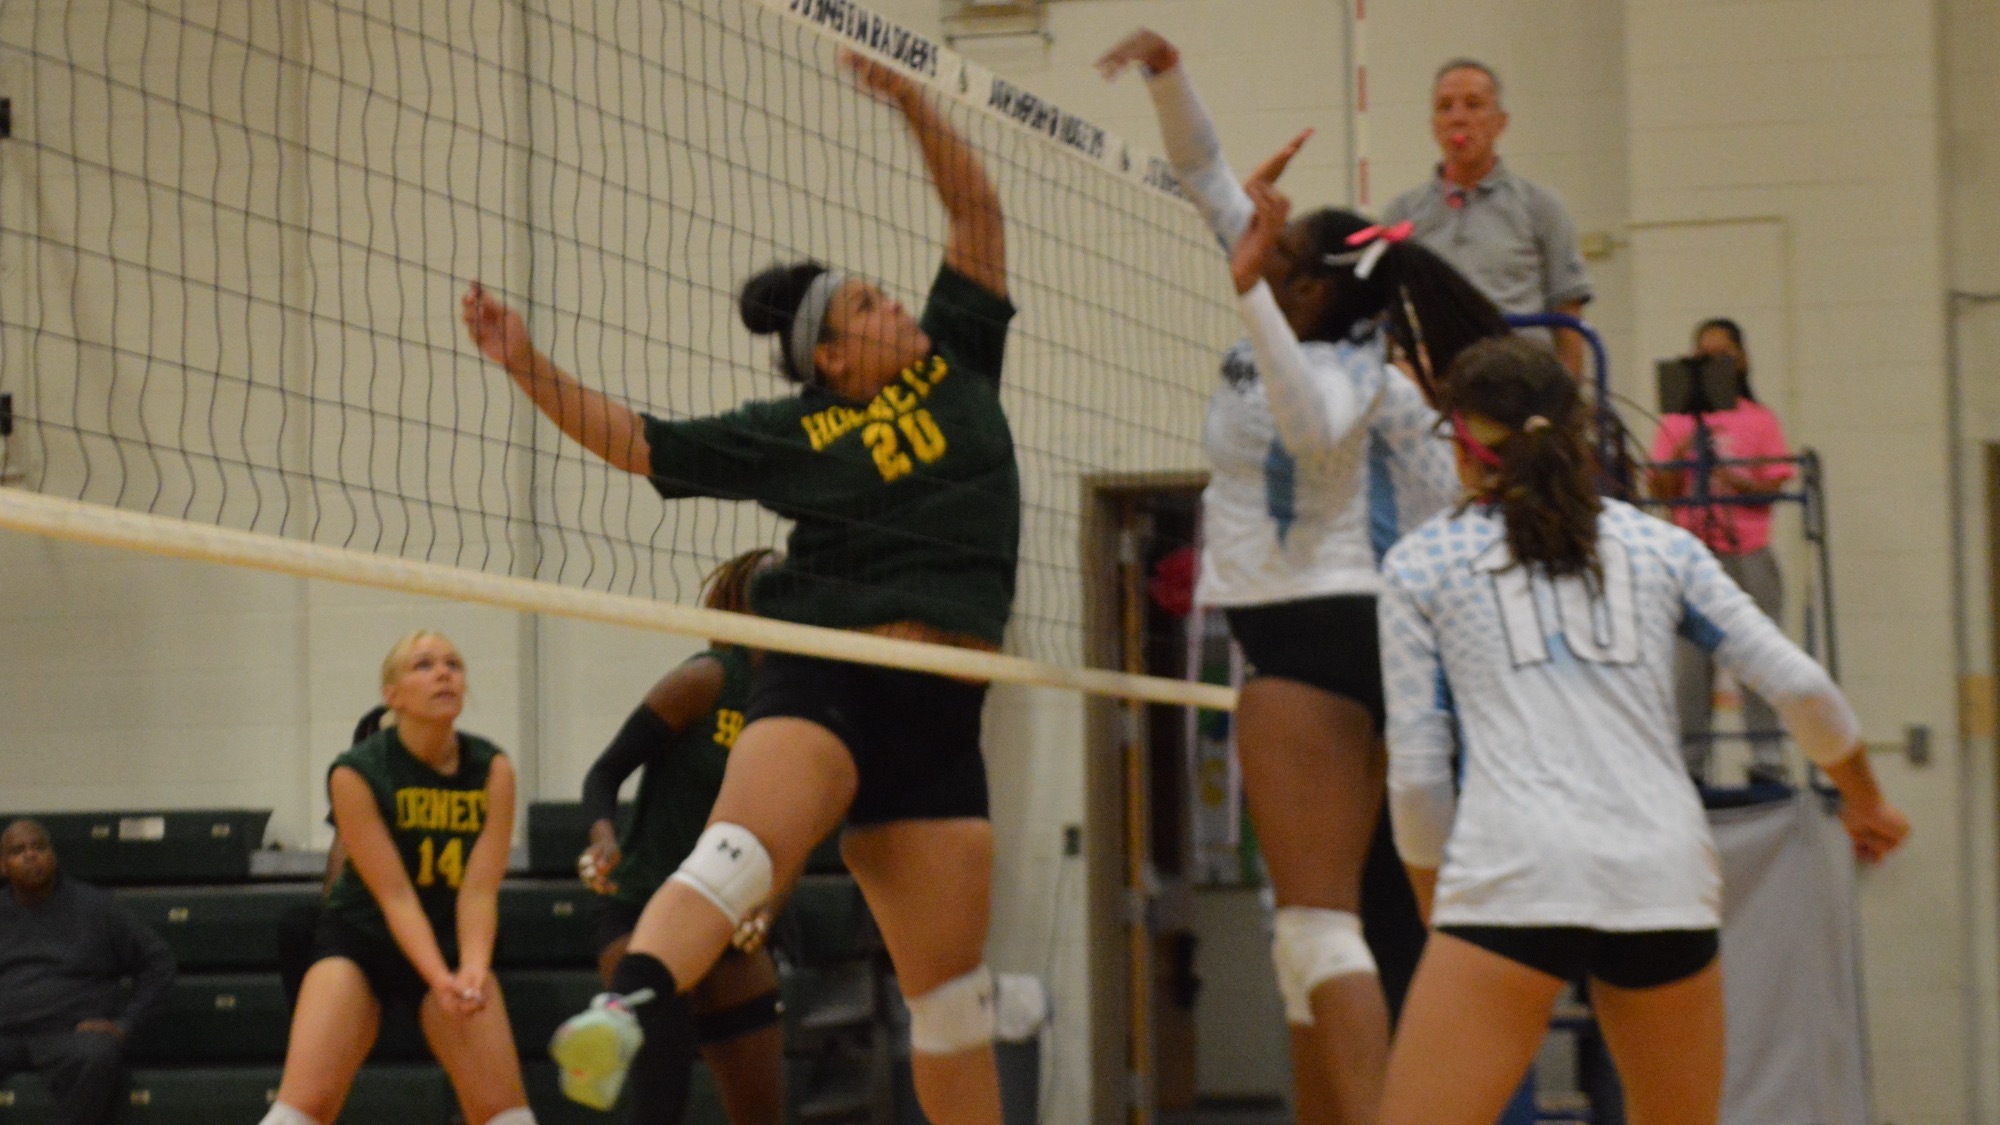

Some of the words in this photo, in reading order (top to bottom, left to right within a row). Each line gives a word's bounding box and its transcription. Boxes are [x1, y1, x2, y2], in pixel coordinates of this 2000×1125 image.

[862, 409, 947, 484] 20
[1468, 534, 1640, 669] 10
[416, 837, 463, 889] 14
